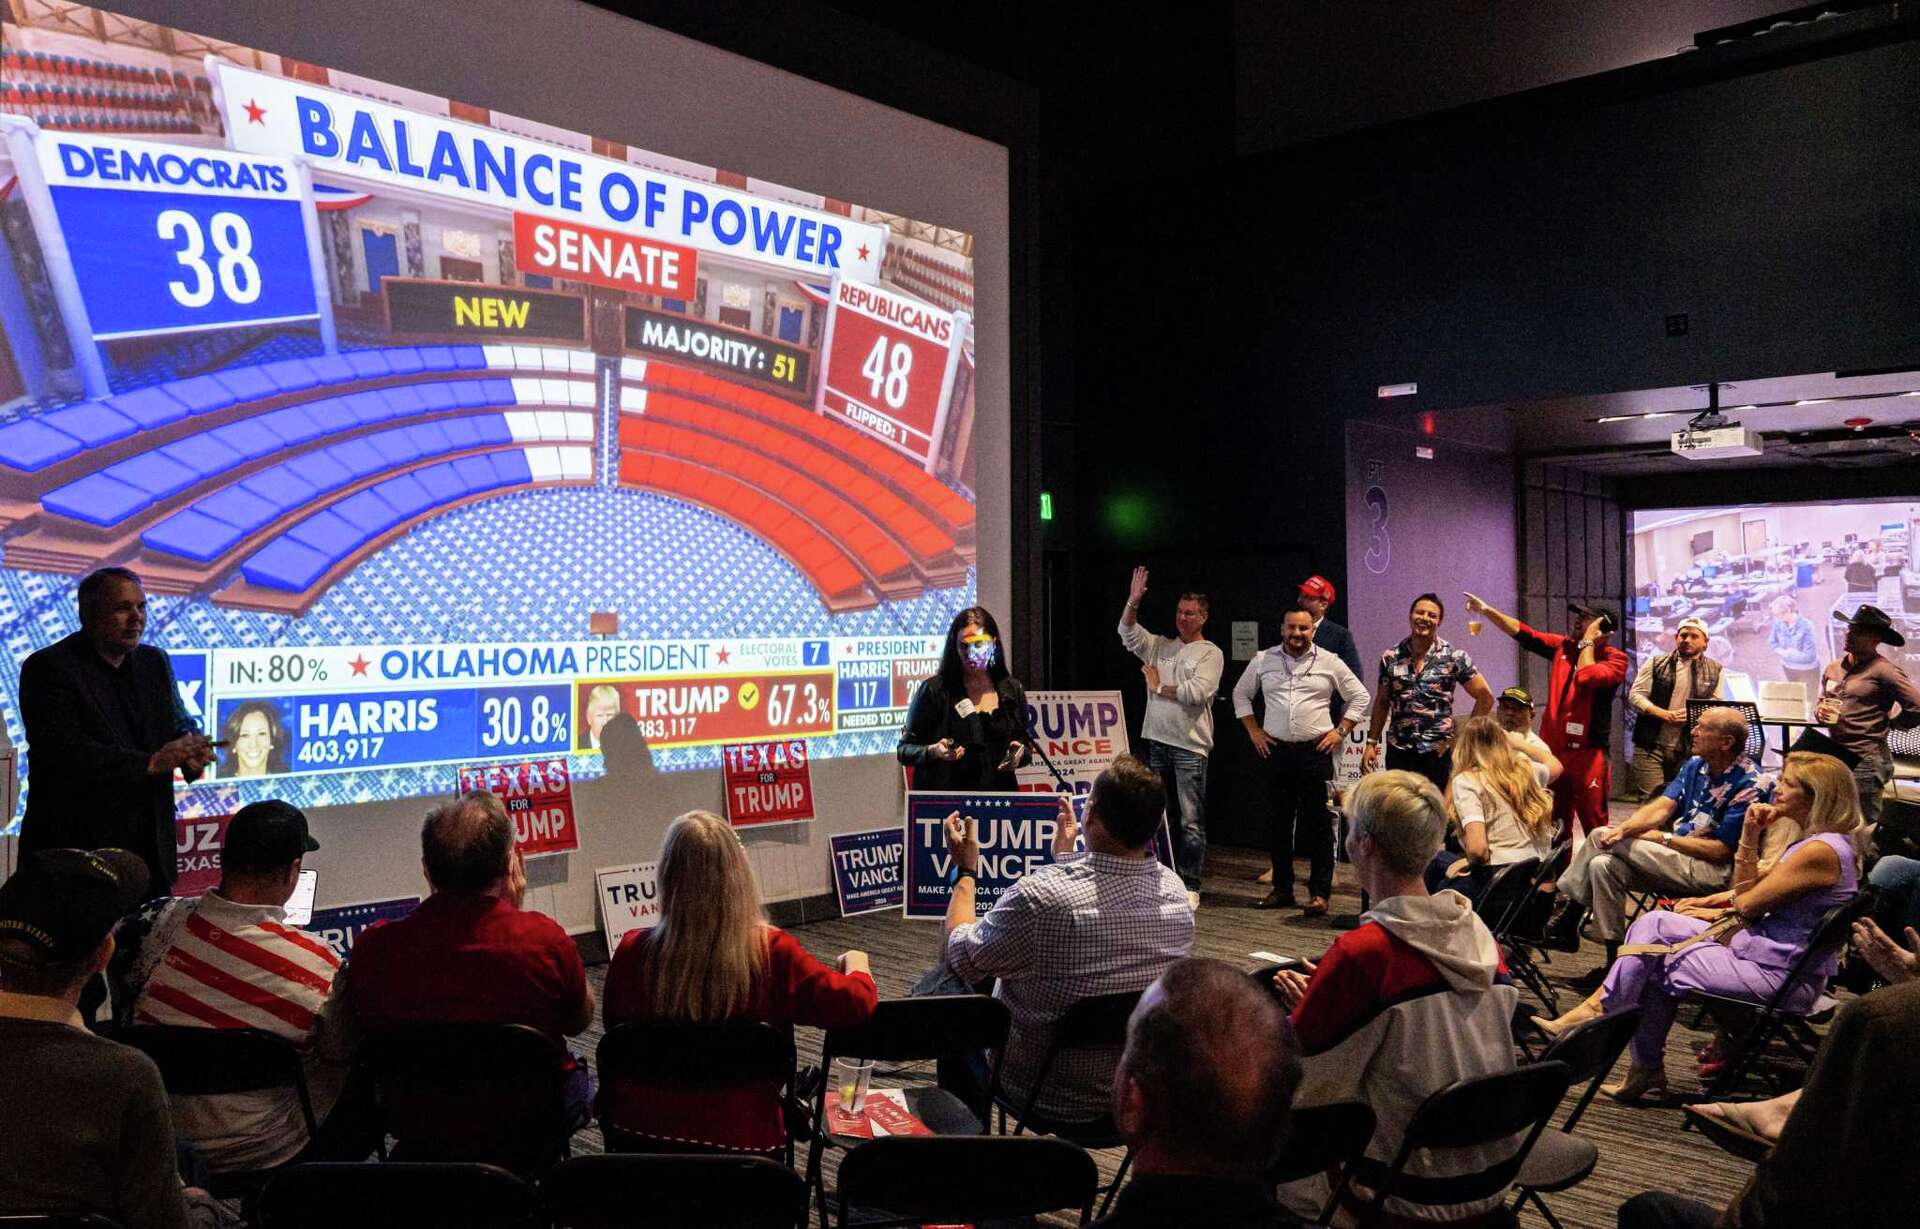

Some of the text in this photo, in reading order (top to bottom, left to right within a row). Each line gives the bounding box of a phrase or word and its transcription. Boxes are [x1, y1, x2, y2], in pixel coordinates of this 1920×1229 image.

[58, 143, 288, 192] DEMOCRATS
[296, 95, 842, 268] BALANCE OF POWER
[156, 210, 261, 308] 38
[533, 225, 679, 290] SENATE
[454, 296, 530, 329] NEW
[839, 282, 951, 341] REPUBLICANS
[771, 353, 796, 382] 51
[862, 335, 912, 409] 48
[846, 402, 907, 444] FLIPPED: 1
[1364, 486, 1391, 574] 3
[380, 643, 710, 681] OKLAHOMA PRESIDENT
[740, 643, 798, 655] ELECTORAL
[763, 656, 798, 667] VOTES
[810, 642, 822, 664] 7
[857, 641, 926, 655] PRESIDENT
[840, 660, 890, 678] HARRIS
[894, 659, 940, 677] TRUMP
[635, 685, 730, 717] TRUMP
[767, 682, 830, 727] 67.3%
[853, 681, 878, 707] 117
[300, 698, 438, 738] HARRIS
[482, 695, 567, 748] 30.8%
[842, 711, 907, 728] NEEDED TO WI
[1025, 702, 1119, 740] RUMP
[298, 738, 384, 764] 403,917
[726, 740, 806, 775] TEXAS
[461, 760, 567, 799] TEXAS
[760, 773, 775, 784] FOR
[511, 799, 529, 811] FOR
[734, 782, 804, 815] TRUMP
[176, 823, 220, 853] UZ
[512, 808, 565, 843] UMP
[177, 854, 221, 873] EXAS
[837, 843, 903, 870] TRUMP
[930, 854, 1044, 879] VNCE
[848, 866, 899, 888] VANCE
[881, 886, 896, 894] GREAT
[918, 886, 945, 894] MAKE
[607, 880, 657, 905] TRU
[976, 902, 994, 911] 202
[629, 902, 661, 917] VAN
